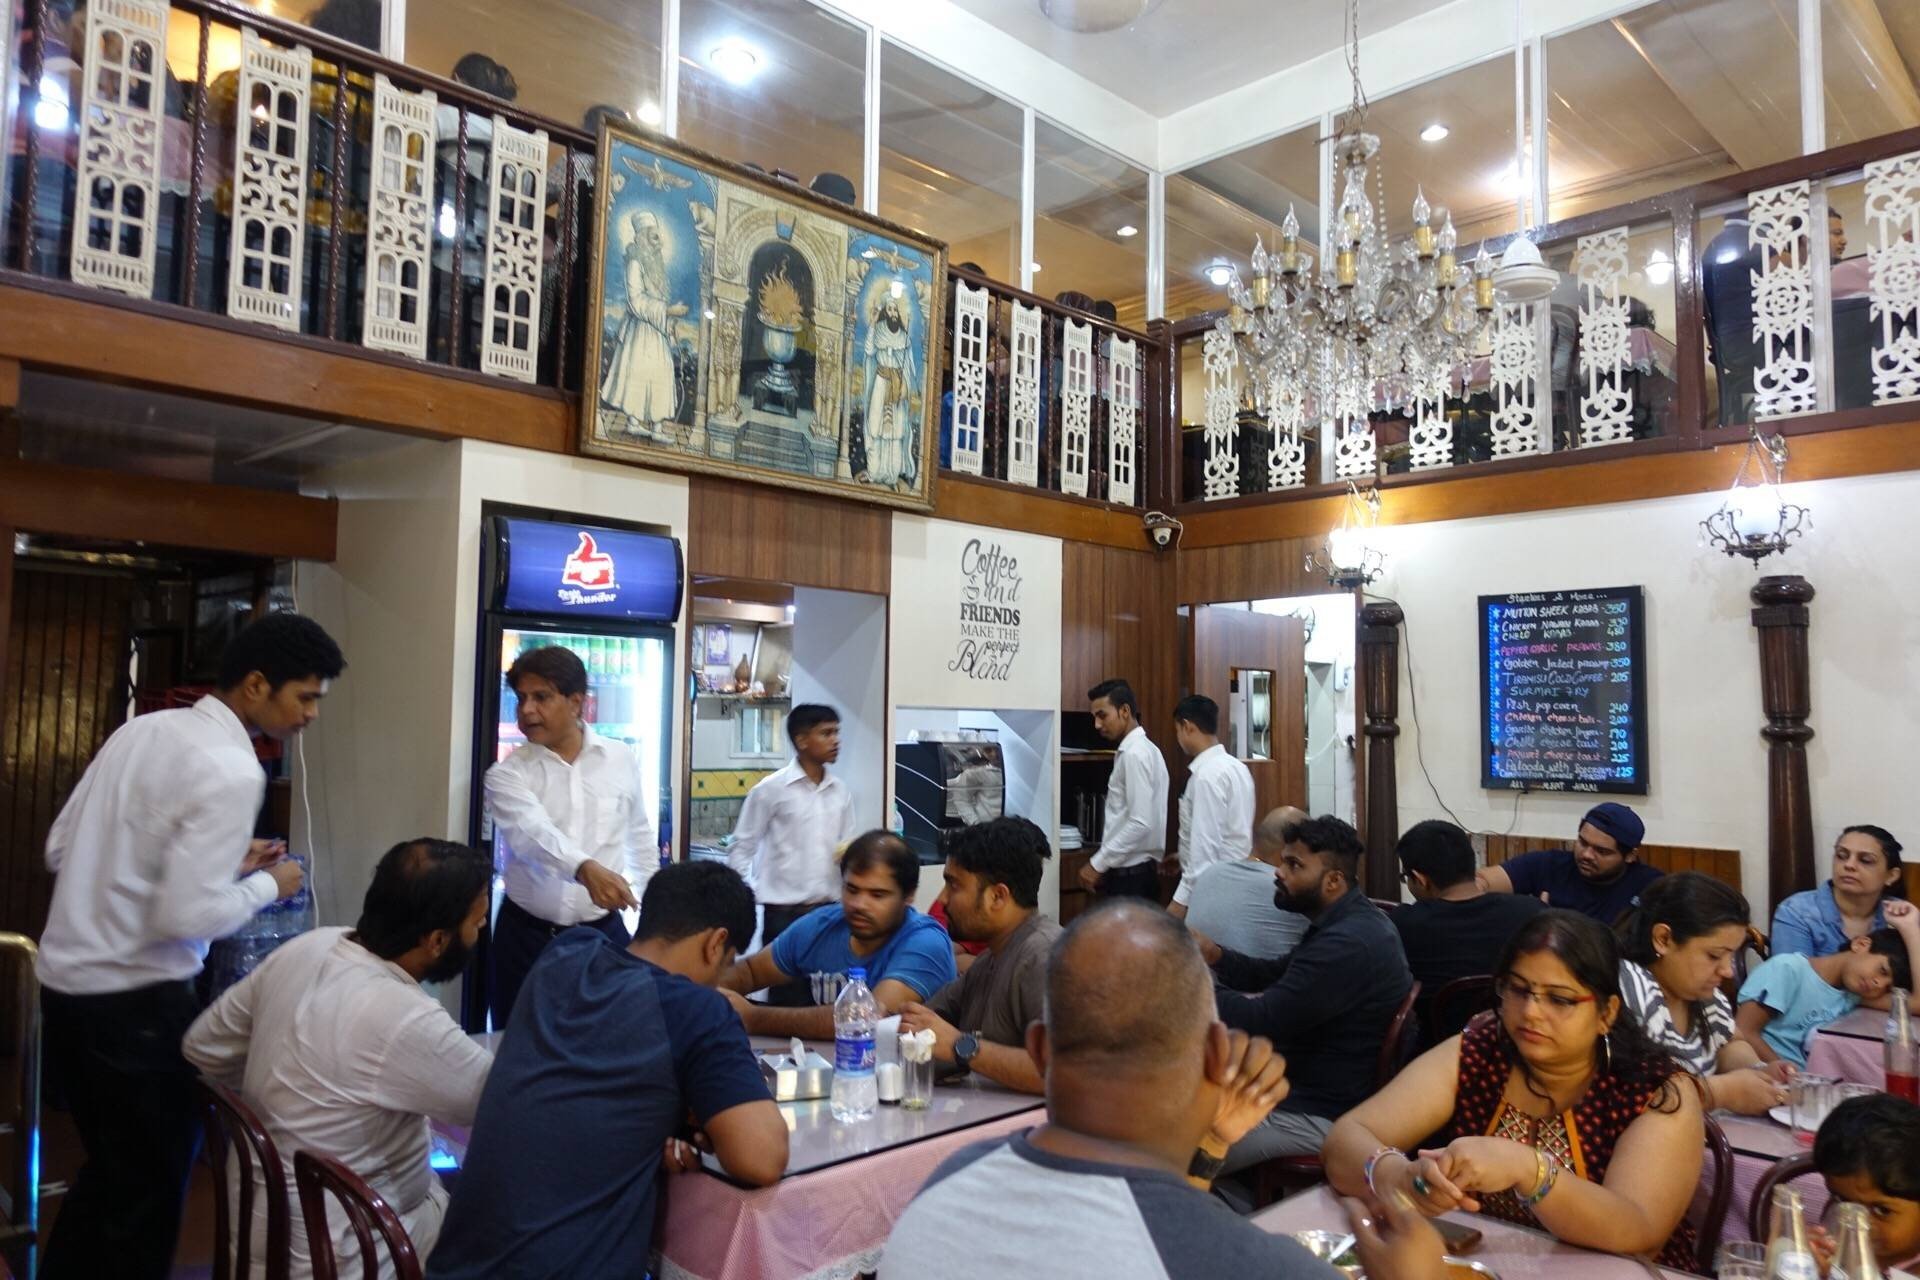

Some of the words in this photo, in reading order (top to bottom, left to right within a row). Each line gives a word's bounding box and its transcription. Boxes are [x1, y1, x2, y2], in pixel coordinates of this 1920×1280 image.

[961, 538, 1018, 588] Coffee
[960, 602, 1021, 626] FRIENDS
[960, 623, 994, 638] MAKE
[996, 627, 1020, 641] THE
[948, 639, 1017, 681] Blend
[983, 640, 1020, 658] perfect
